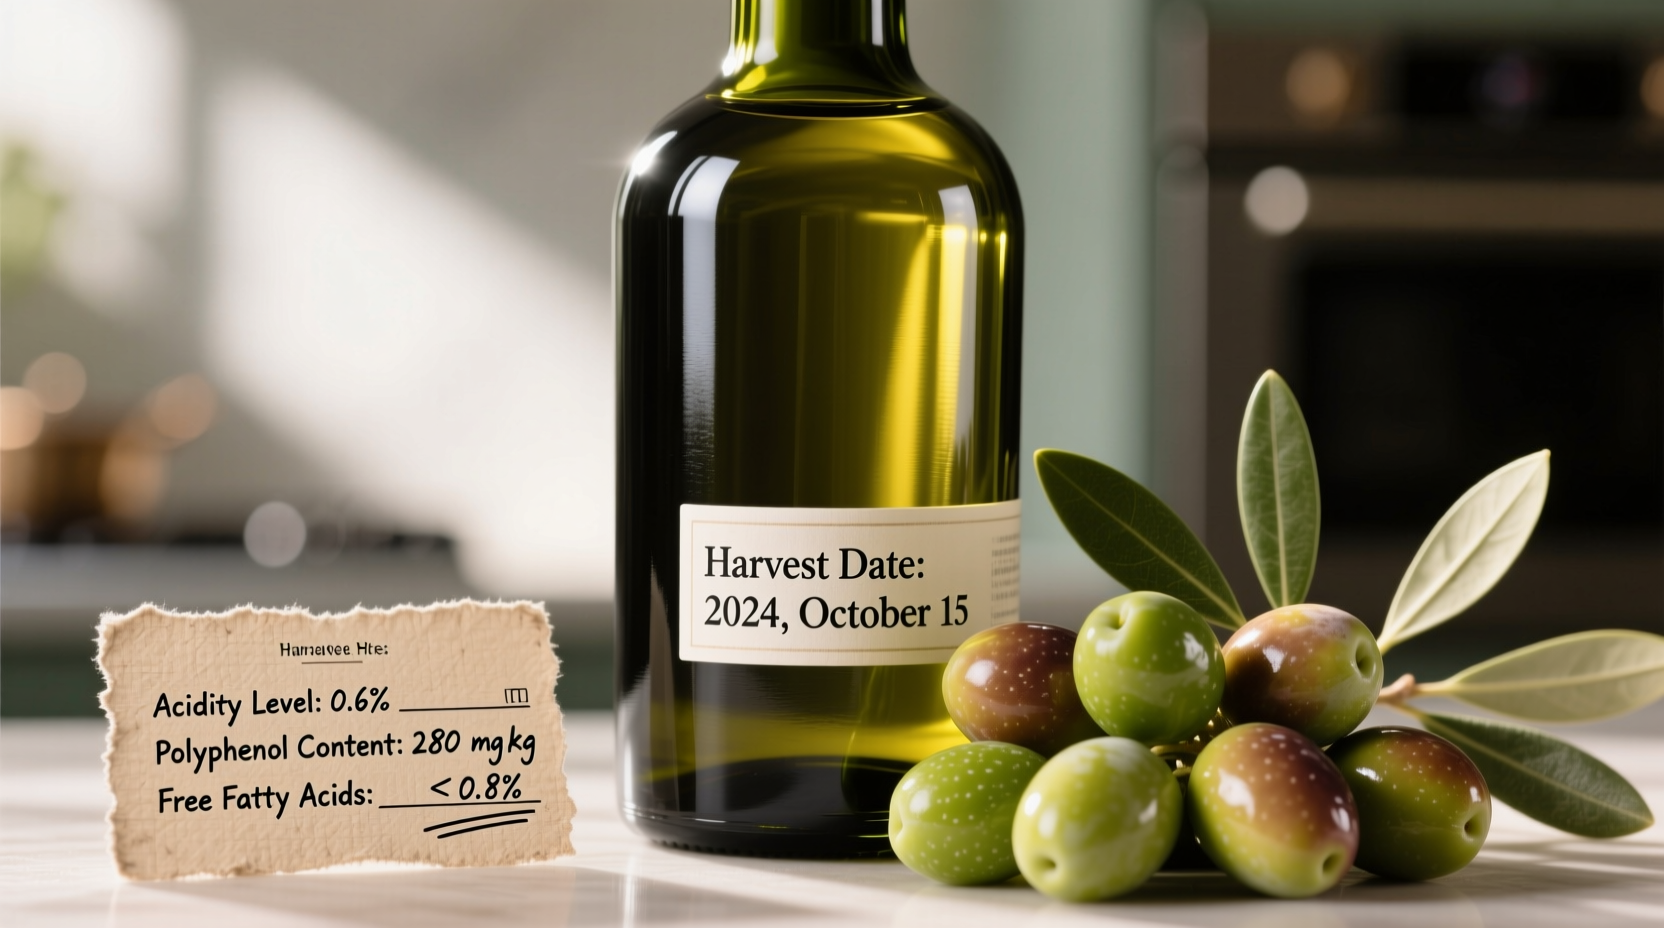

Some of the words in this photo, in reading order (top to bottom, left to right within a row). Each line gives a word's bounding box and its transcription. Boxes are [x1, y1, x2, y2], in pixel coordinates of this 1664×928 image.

[704, 546, 830, 580] Harvest
[838, 548, 925, 580] Date:
[704, 594, 789, 635] 2024,
[799, 595, 932, 629] October
[940, 594, 969, 627] 15
[152, 691, 243, 728] Acidity
[252, 688, 321, 716] Level:
[330, 686, 390, 714] 0.6%
[155, 734, 288, 775] Polyphenol
[297, 733, 403, 759] Content:
[411, 728, 461, 755] 280
[158, 787, 213, 814] Free
[222, 785, 290, 820] Fatty
[298, 780, 373, 809] Acids:
[458, 773, 522, 801] 0.8%
